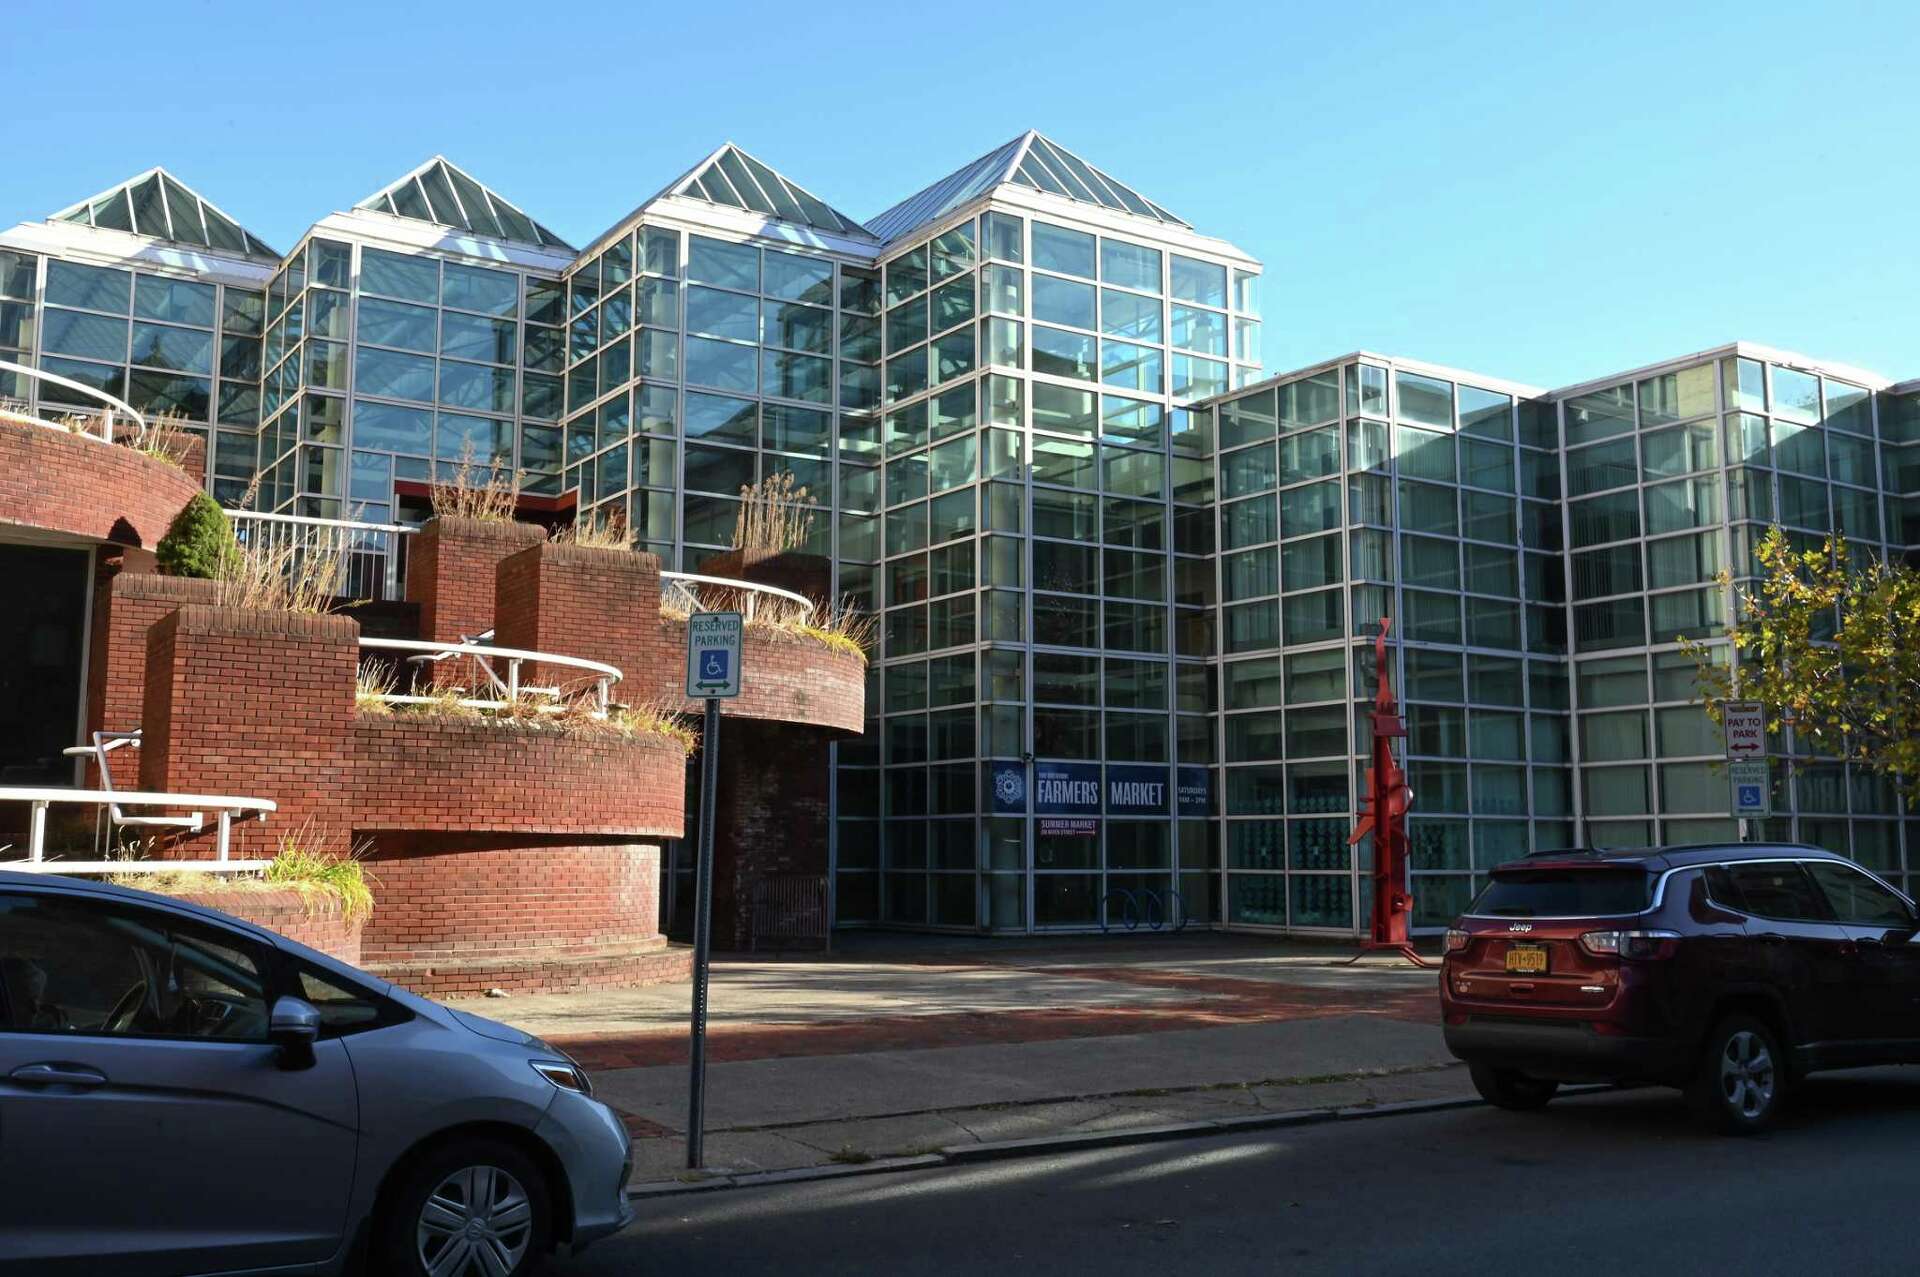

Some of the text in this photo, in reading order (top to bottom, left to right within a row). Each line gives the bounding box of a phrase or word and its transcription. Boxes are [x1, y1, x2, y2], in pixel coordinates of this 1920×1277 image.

[692, 621, 739, 632] RESERVED
[695, 635, 736, 646] PARKING
[1727, 718, 1761, 727] PAY TO
[1733, 729, 1758, 738] PARK
[1733, 776, 1765, 784] PARKING
[1038, 780, 1164, 806] FARMERS MARKET
[1040, 820, 1096, 830] SUMMER MARKET
[1509, 922, 1533, 933] Jeep
